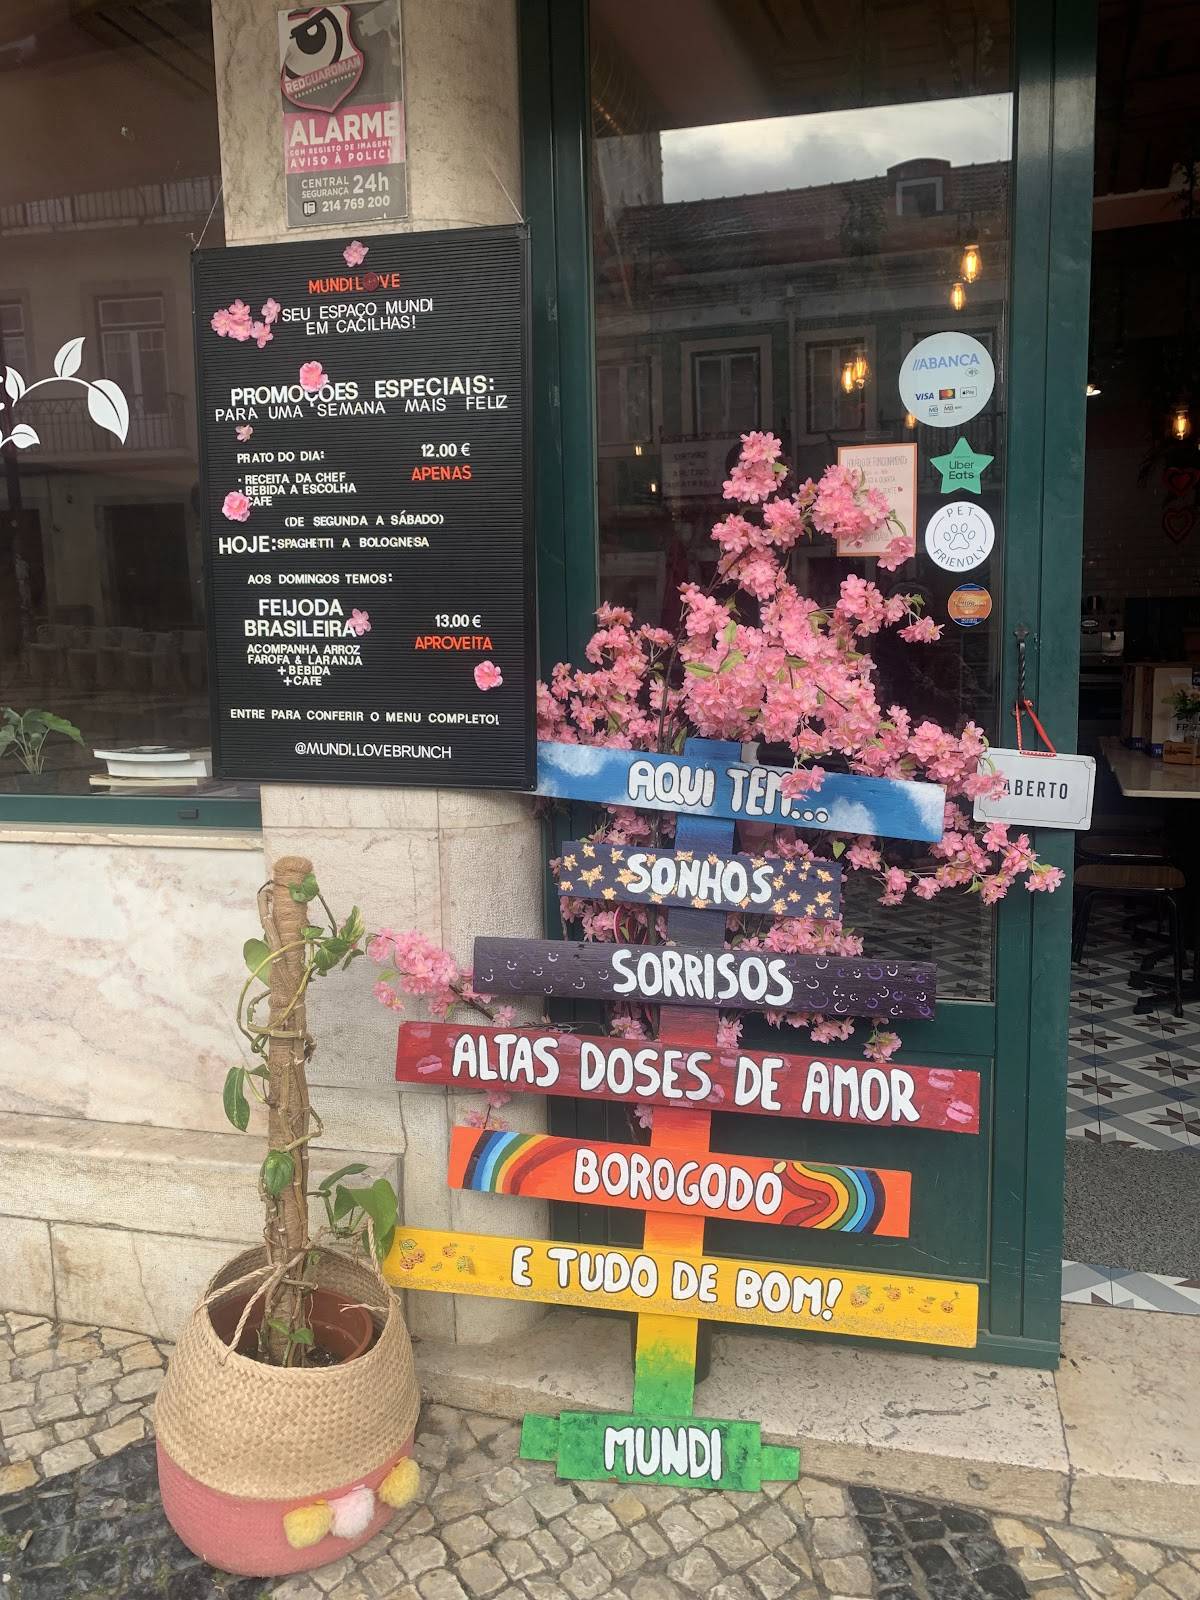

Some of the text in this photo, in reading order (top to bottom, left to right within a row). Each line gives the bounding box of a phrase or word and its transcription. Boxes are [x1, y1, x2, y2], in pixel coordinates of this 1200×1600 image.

[290, 110, 400, 147] ALARME
[344, 143, 354, 151] DE
[290, 149, 391, 168] AVISO À POLICI
[301, 175, 349, 188] CENTRAL
[353, 172, 389, 194] 24h
[301, 187, 349, 199] SEGURANÇA
[322, 195, 390, 212] 214 769 200
[281, 298, 433, 322] SEU ESPAÇO MUNDI
[306, 321, 328, 335] EM
[374, 375, 494, 398] ESPECIAIS:
[915, 392, 935, 401] VISA
[215, 395, 508, 421] PARA UMA SEMANA MAIS FELIZ
[237, 450, 325, 463] PRATO DO DIA:
[421, 442, 471, 458] 12.00 €
[411, 465, 472, 480] APENAS
[949, 460, 974, 470] Uber
[245, 472, 346, 485] RECEITA DA CHEF
[948, 470, 975, 480] Eats
[245, 483, 357, 495] BEBIDA A ESCOLHA
[284, 510, 444, 527] (DE SEGUNDA A SÁBADO)
[946, 505, 976, 518] PET
[218, 535, 430, 554] HOJE: SPAGHETTI A BOLOGNESA
[933, 546, 986, 568] FRIENDLY
[247, 573, 393, 584] AOS DOMINGOS TEMOS:
[258, 598, 344, 616] FEIJODA
[244, 619, 357, 637] BRASILEIRA
[434, 614, 482, 628] 13.00 €
[247, 644, 361, 655] ACOMPANHA ARROZ
[414, 635, 493, 650] APROVEITA
[247, 654, 363, 665] FAROFA & LARANJA
[230, 708, 500, 725] ENTRE PARA CONFERIR O MENU COMPLETO!
[295, 742, 452, 759] @MUNDI.LOVEBRUNCH
[628, 760, 716, 807] AQUI
[626, 853, 774, 904] SONHOS
[612, 948, 794, 1006] SORRISOS
[452, 1033, 921, 1123] ALTAS DOSES DE AMOR
[573, 1148, 788, 1216] BOROGODÓ
[511, 1246, 844, 1322] E TUDO DE BOM!
[603, 1426, 724, 1482] MUNDI
